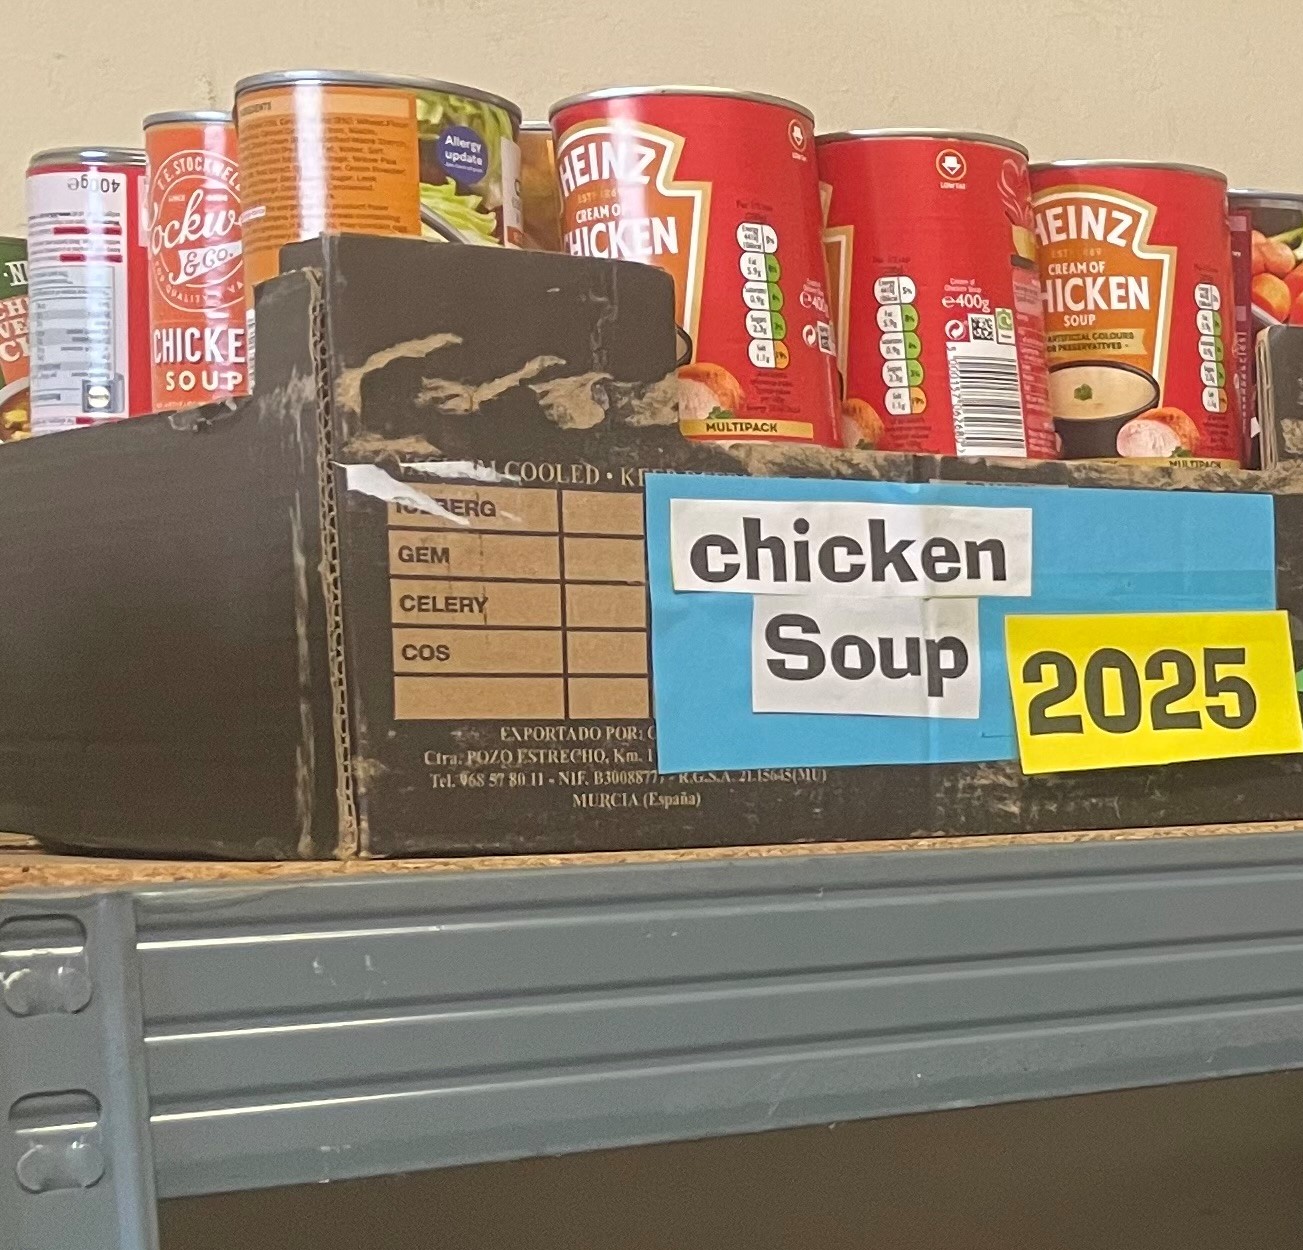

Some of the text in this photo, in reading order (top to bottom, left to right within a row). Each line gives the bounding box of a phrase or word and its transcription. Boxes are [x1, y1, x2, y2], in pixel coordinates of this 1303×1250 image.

[445, 135, 481, 152] Allergy
[445, 151, 482, 165] update
[560, 141, 656, 197] HEINZ
[576, 205, 609, 223] CREAM
[1048, 261, 1105, 275] CREAM OF
[1040, 276, 1150, 313] HICKEN
[1063, 314, 1096, 327] SOUP
[153, 327, 246, 364] CHICKE
[166, 370, 243, 391] SOUP
[706, 422, 778, 433] MULTIPACK
[504, 461, 600, 485] COOLED
[398, 546, 449, 565] GEM
[689, 517, 1007, 583] chicken
[399, 596, 488, 614] CELERY
[401, 643, 450, 661] COS
[765, 613, 968, 697] Soup
[1022, 647, 1257, 736] 2025
[500, 726, 644, 742] EXPORTADO POR:
[467, 749, 513, 766] POZO
[613, 748, 644, 764] Km.
[429, 773, 456, 789] Tel.
[459, 772, 486, 788] 968
[488, 772, 506, 788] 57
[509, 772, 526, 788] 80
[594, 770, 664, 786] B3008877
[573, 791, 701, 810] MURCIA (España)
